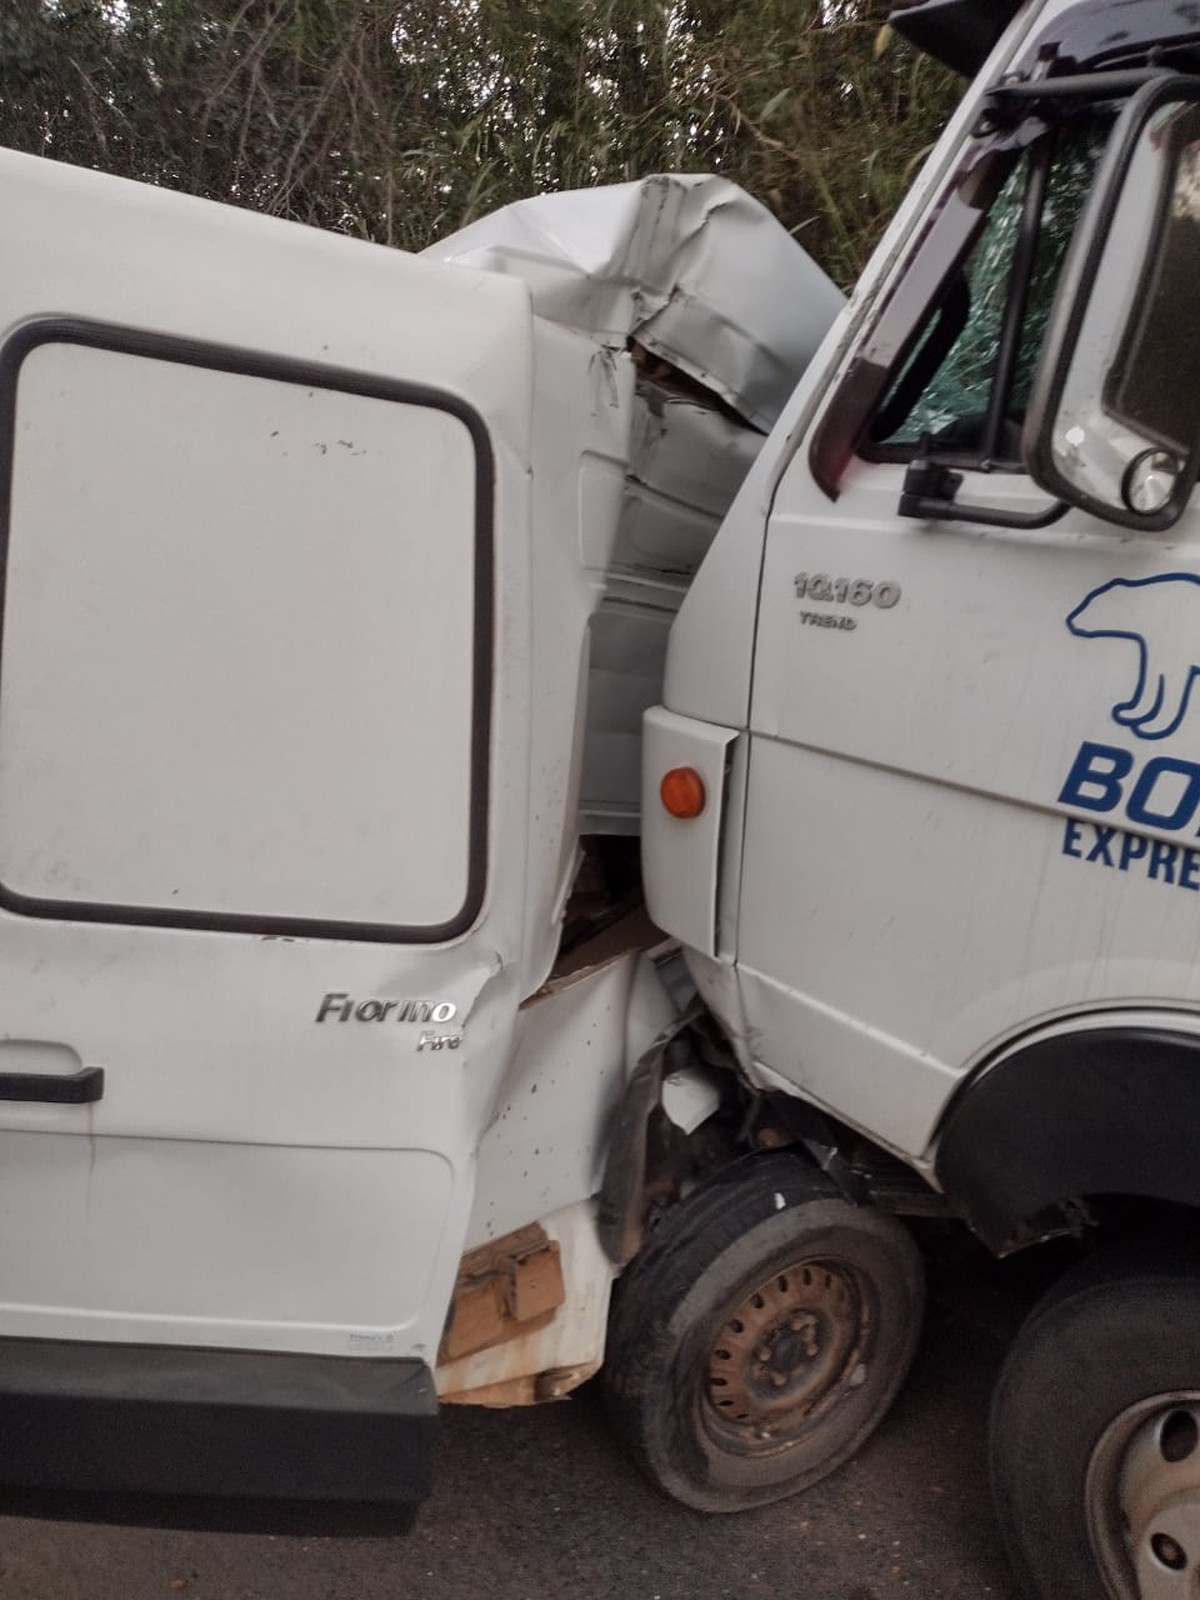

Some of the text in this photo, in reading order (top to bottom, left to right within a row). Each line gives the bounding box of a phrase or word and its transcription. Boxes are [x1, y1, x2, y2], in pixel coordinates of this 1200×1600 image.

[799, 611, 857, 631] TREND
[1057, 741, 1200, 838] BO
[315, 992, 456, 1023] Fiorino
[416, 1030, 463, 1052] Fire
